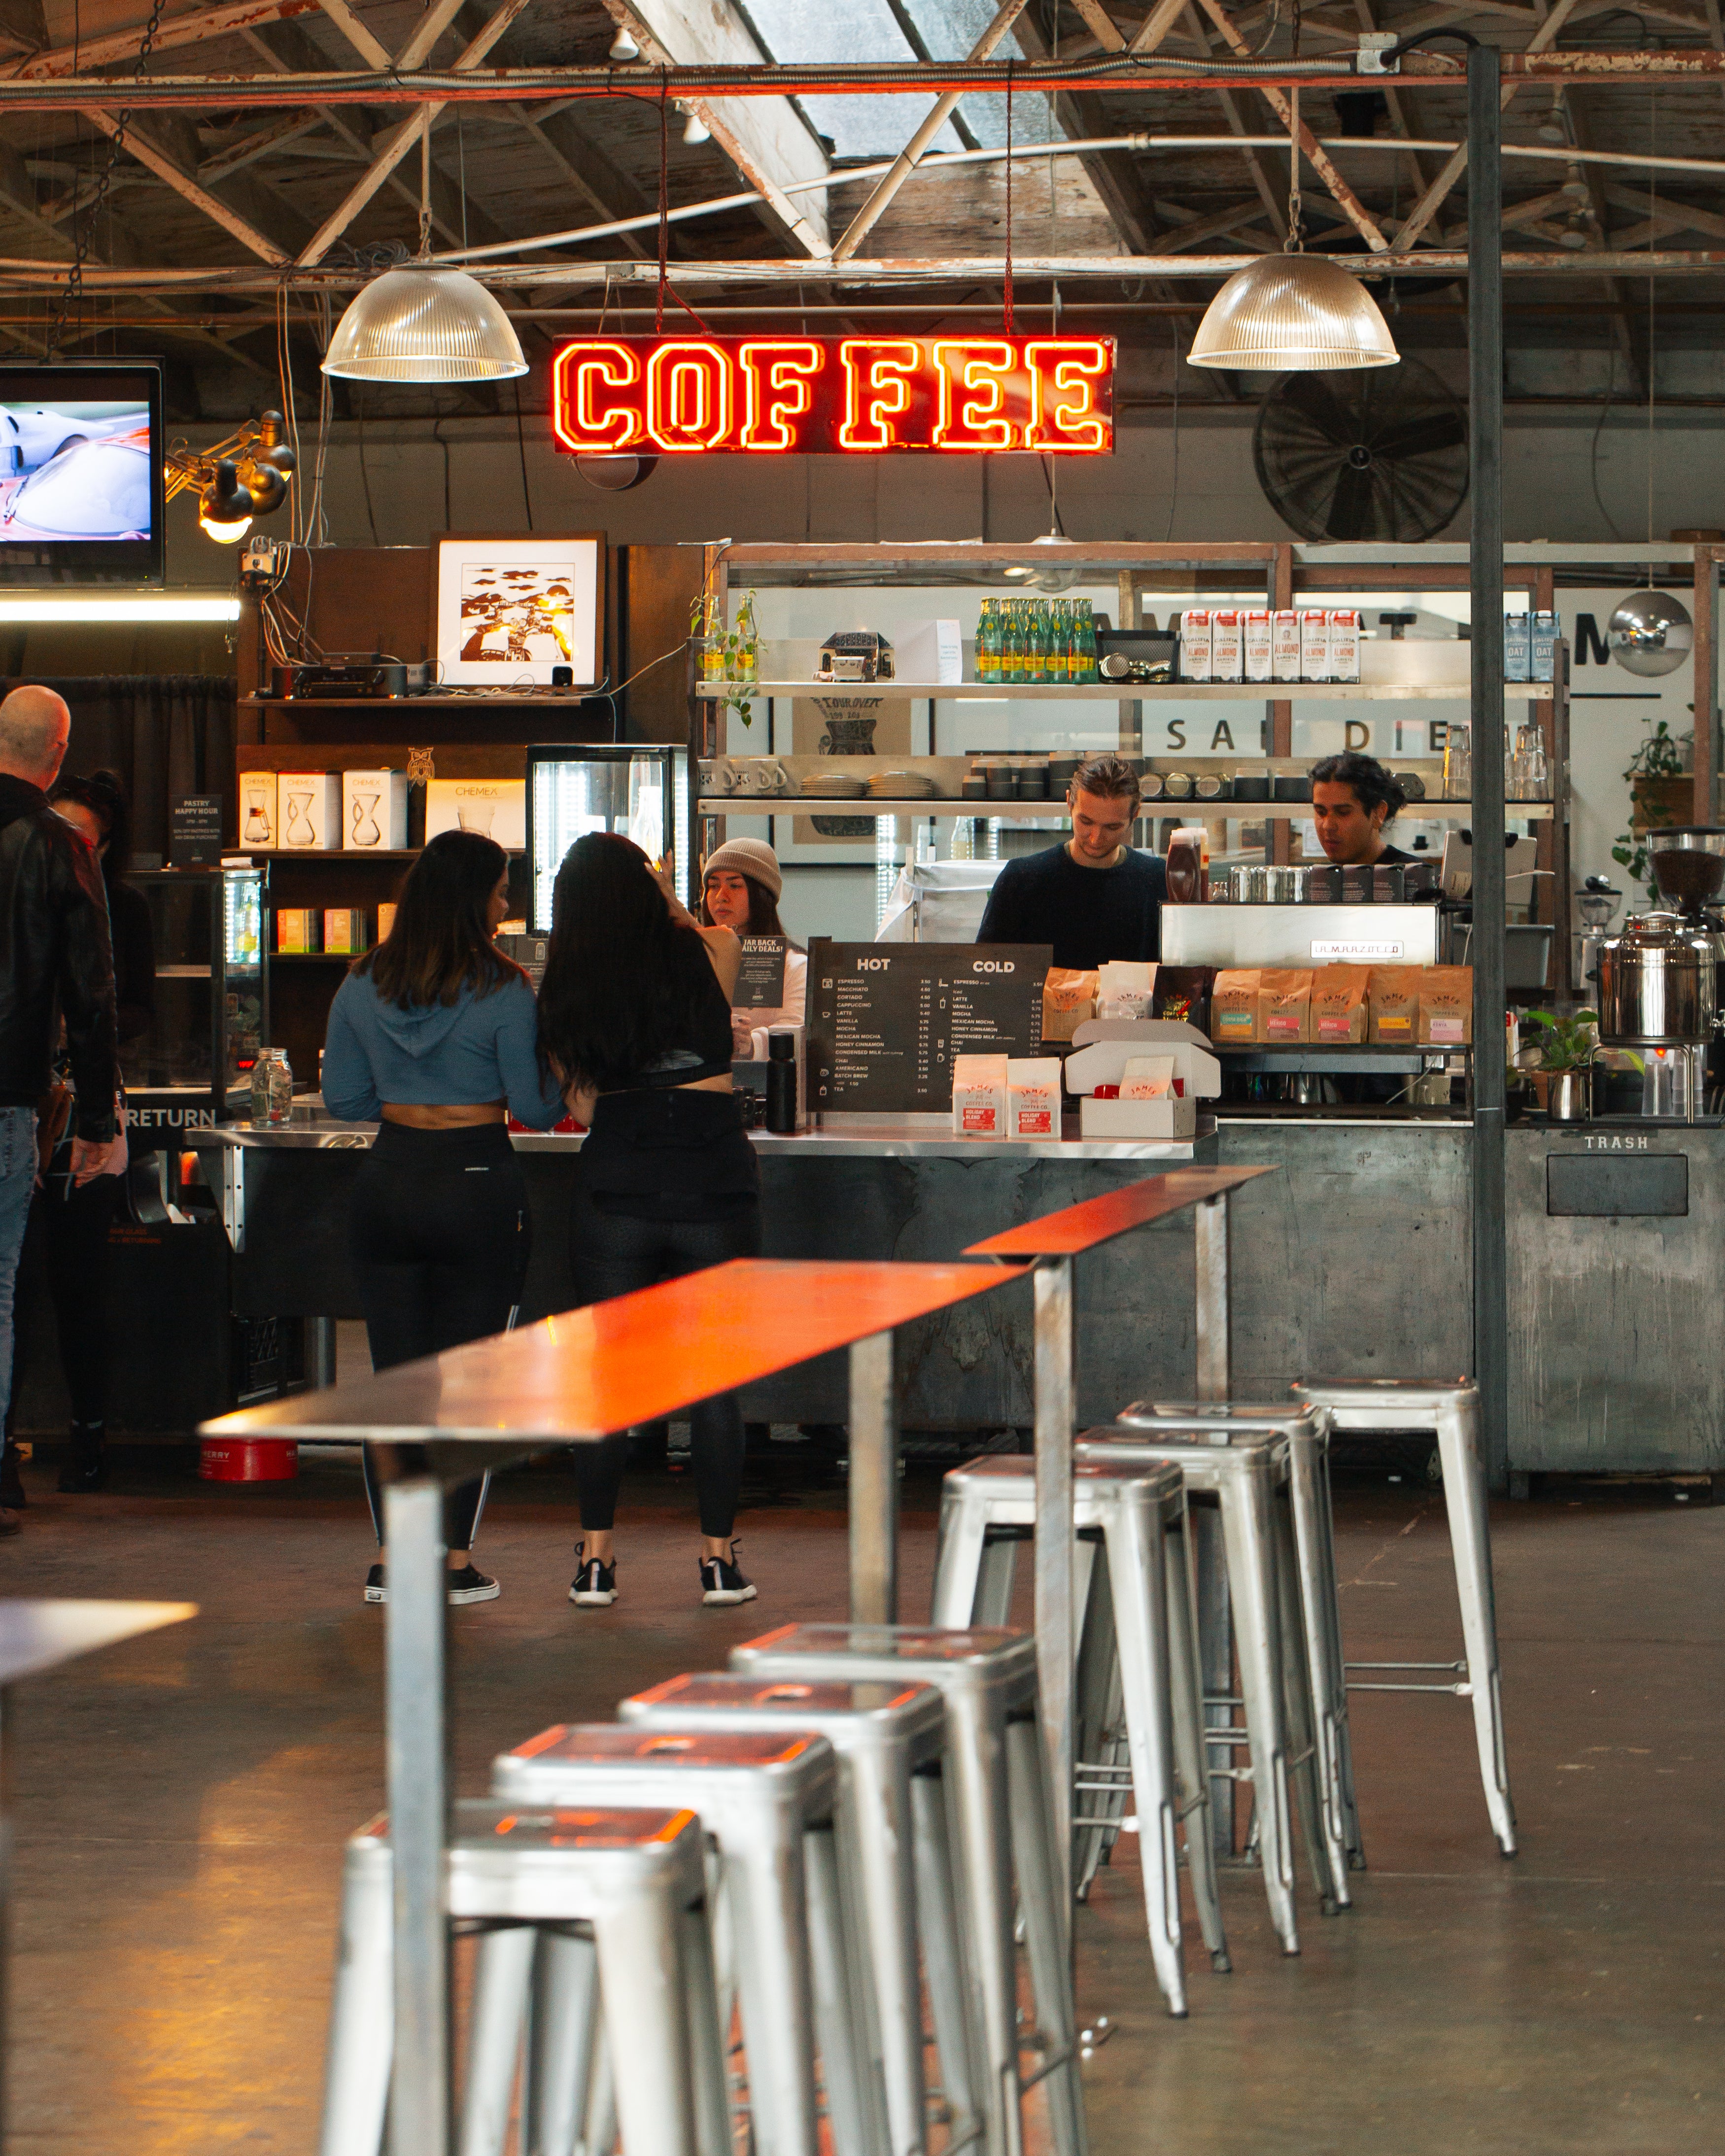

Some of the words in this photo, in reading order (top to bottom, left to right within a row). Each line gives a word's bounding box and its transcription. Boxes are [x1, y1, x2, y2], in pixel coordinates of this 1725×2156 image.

[554, 340, 1107, 450] COFFEE
[1188, 648, 1208, 656] ALMOND
[1216, 648, 1236, 656] ALMOND
[1250, 648, 1269, 656] ALMOND
[1275, 644, 1299, 654] ALMOND
[1305, 648, 1325, 656] ALMOND
[1334, 648, 1354, 656] ALMOND
[1508, 647, 1523, 656] OAT
[1536, 647, 1551, 656] OAT
[1167, 719, 1266, 750] SA
[455, 787, 498, 795] CHEMEX
[857, 958, 891, 970] HOT
[973, 961, 1015, 973] COLD
[1224, 991, 1249, 1000] JAMES
[1323, 995, 1349, 1005] JAMES
[1432, 995, 1460, 1004] JAMES
[966, 1085, 993, 1094] JAMES
[1021, 1089, 1048, 1097] JAMES
[1132, 1086, 1156, 1095] JAMES
[126, 1109, 216, 1127] RETURN
[1585, 1136, 1647, 1149] TRASH
